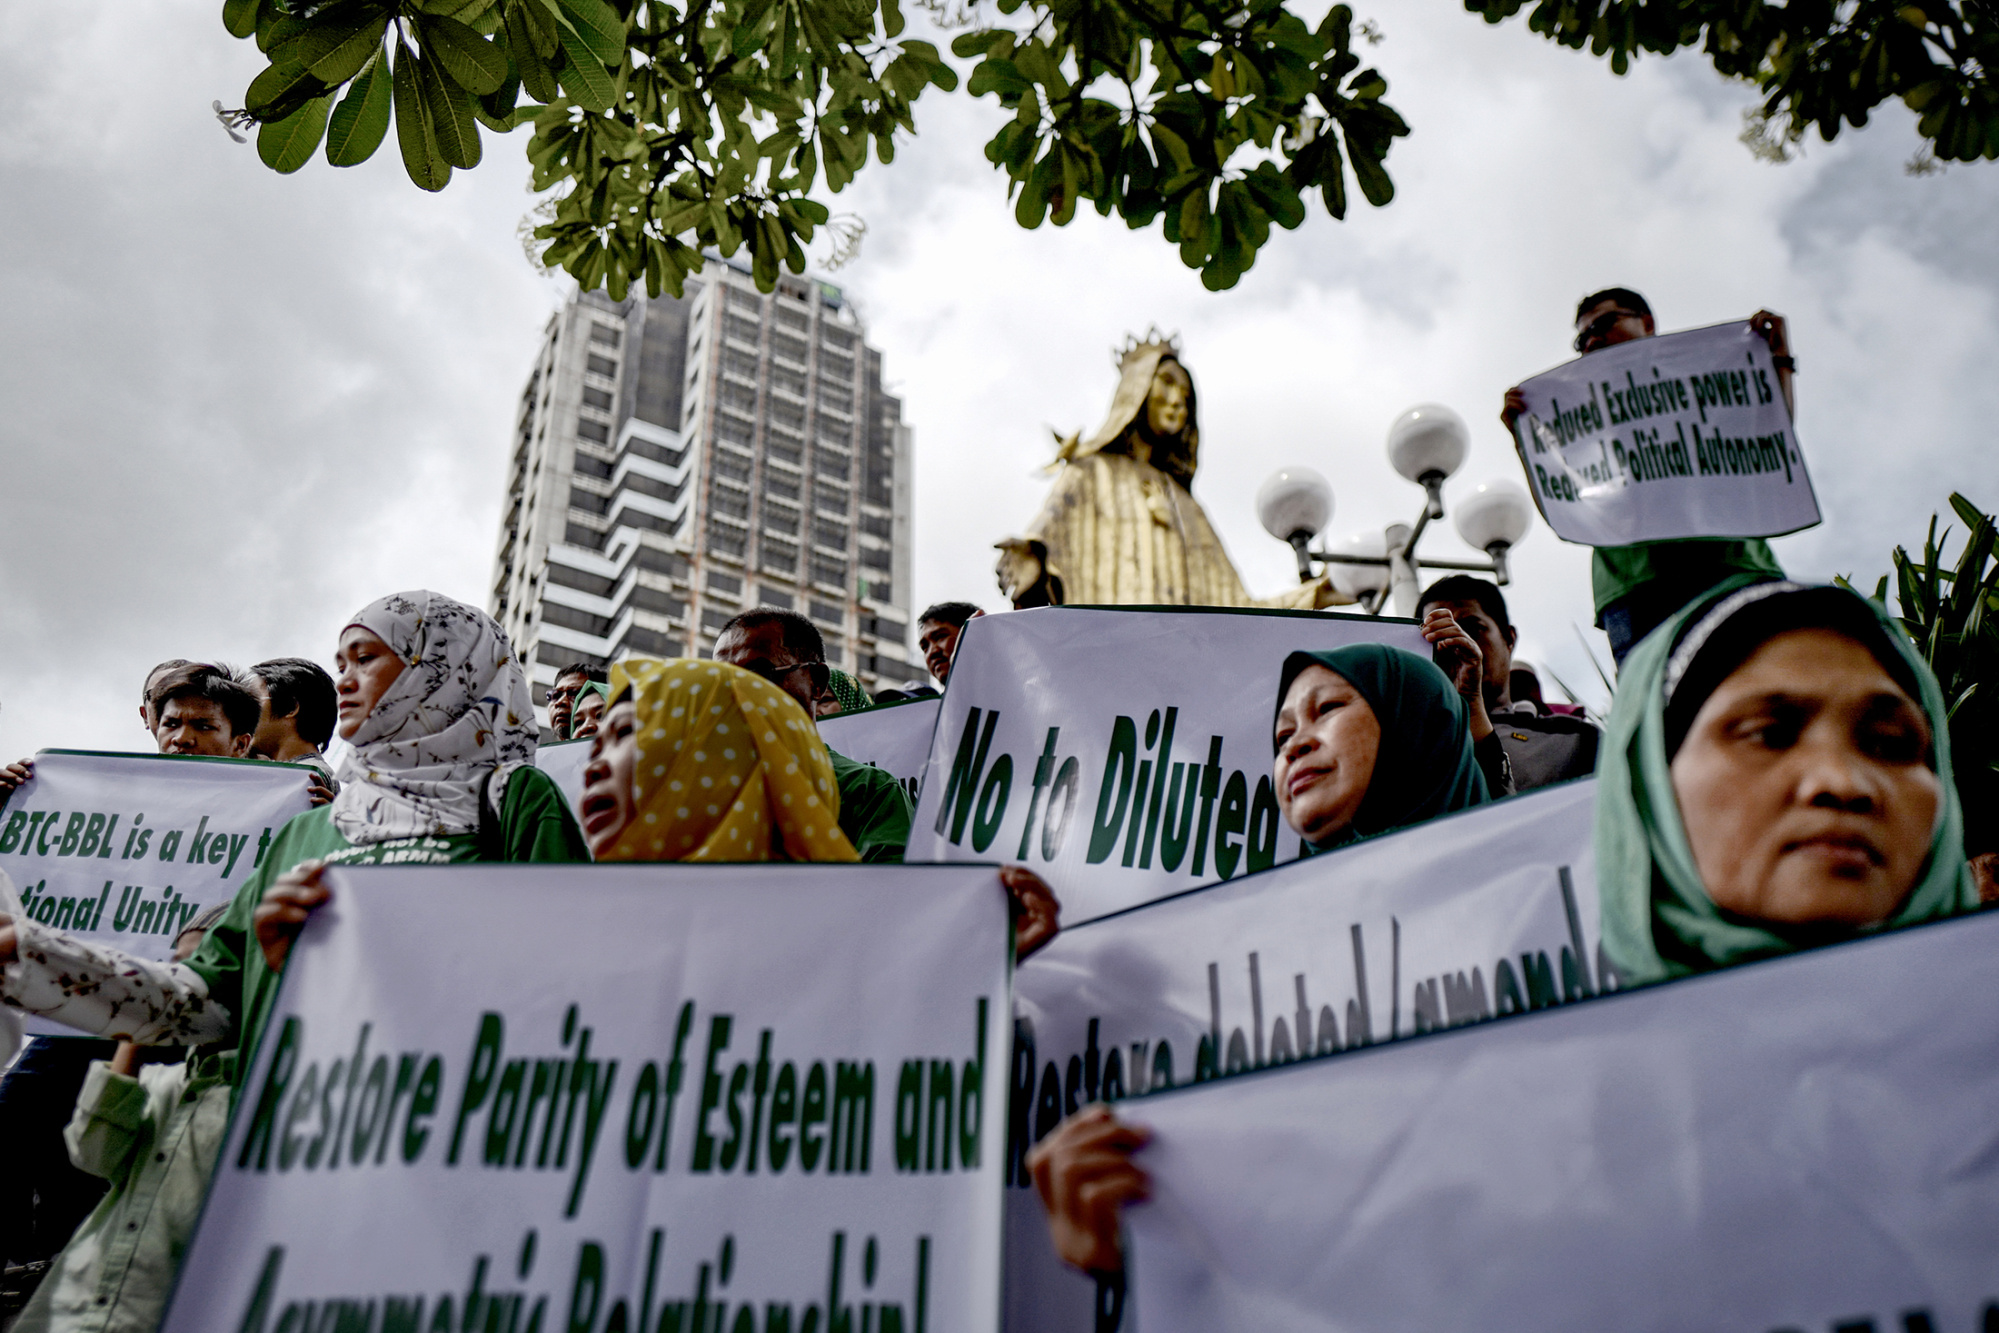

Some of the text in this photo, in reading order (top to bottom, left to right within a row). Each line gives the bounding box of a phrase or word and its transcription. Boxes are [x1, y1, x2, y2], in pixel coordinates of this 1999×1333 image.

[1601, 366, 1690, 425] Exclusive
[1690, 369, 1750, 424] power
[1747, 351, 1773, 405] is
[1611, 420, 1694, 488] Political
[1691, 423, 1798, 484] Autonomy.
[934, 706, 1014, 854] No
[1016, 726, 1080, 862] to
[0, 809, 272, 879] BTC-BBL is a key t
[18, 878, 114, 932] tional
[236, 996, 991, 1223] Restore Parity of Esteem and
